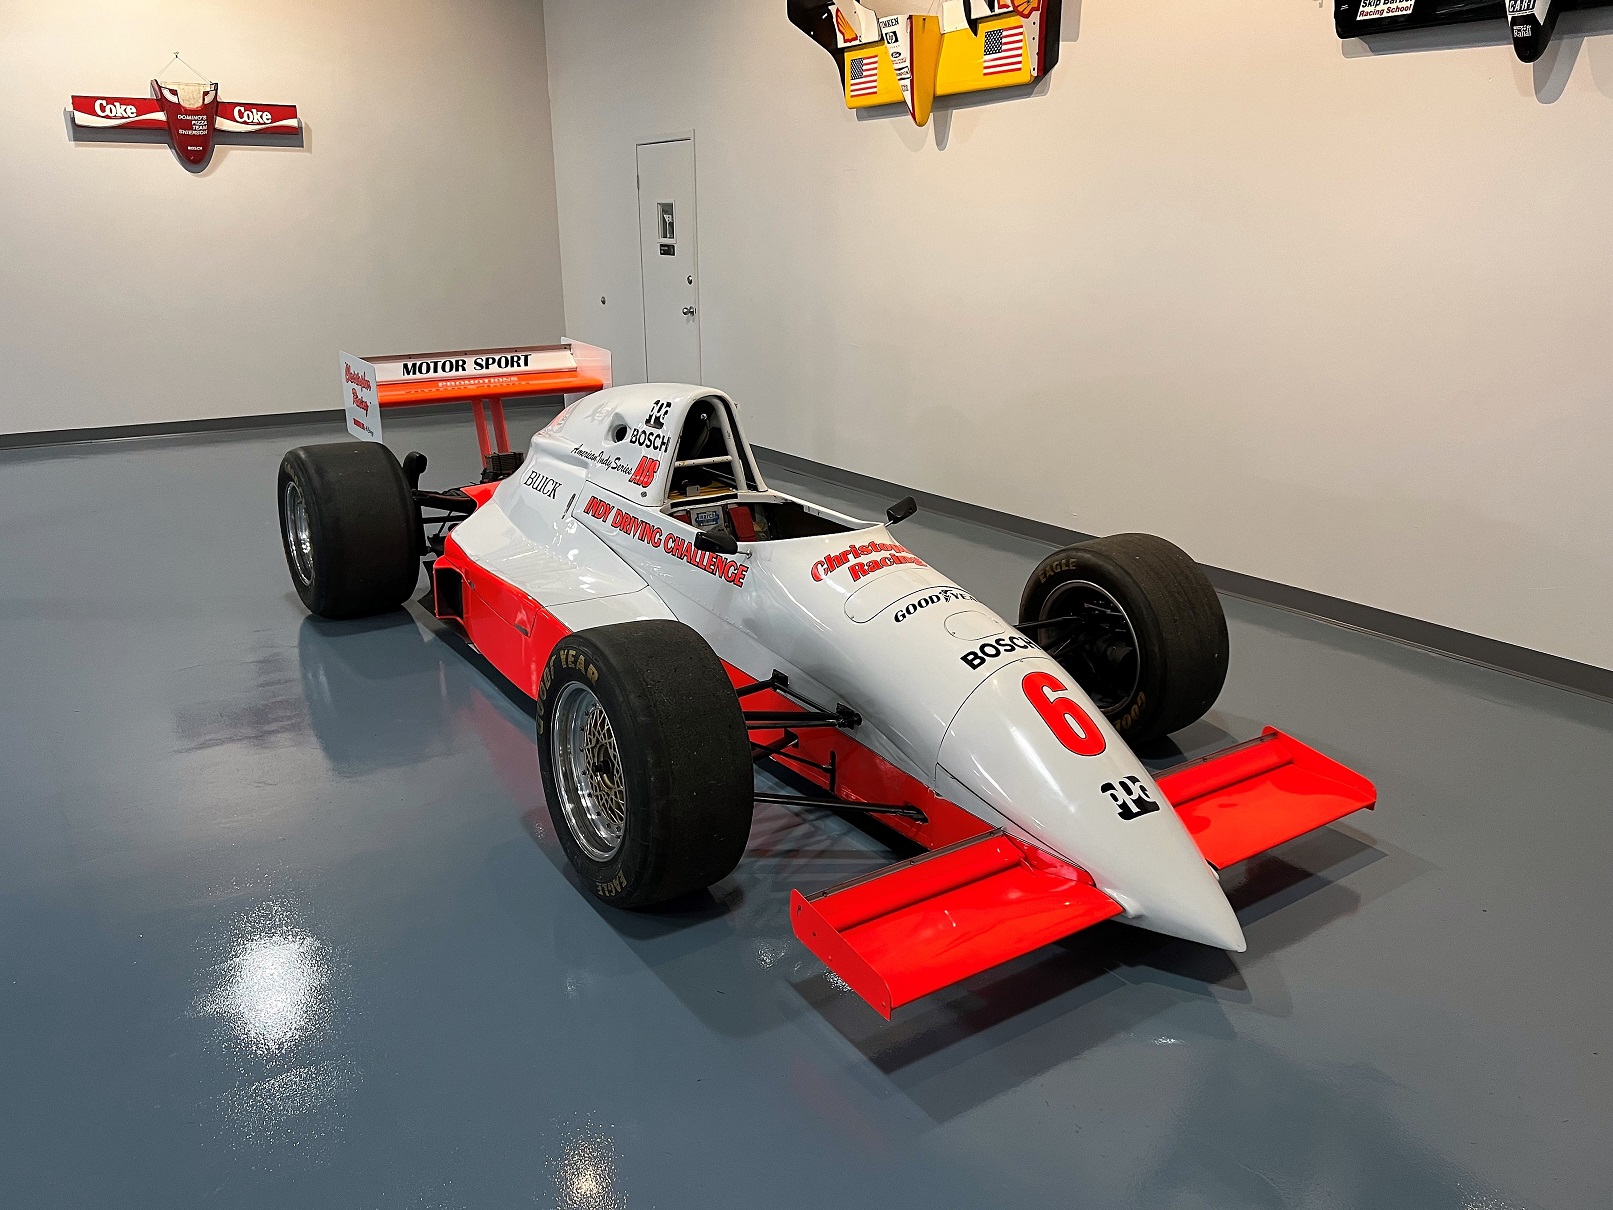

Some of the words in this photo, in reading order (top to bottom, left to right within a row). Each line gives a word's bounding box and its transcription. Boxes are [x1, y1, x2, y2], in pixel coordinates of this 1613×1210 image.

[1359, 9, 1385, 18] Racing
[1386, 4, 1412, 14] School
[94, 99, 137, 118] Coke
[233, 106, 272, 124] Coke
[402, 359, 467, 376] MOTOR
[473, 354, 532, 371] SPORT
[438, 376, 519, 388] PROMOTIONS
[629, 427, 671, 454] BOSCH
[611, 456, 634, 476] Series
[523, 469, 563, 500] BUICK
[583, 495, 615, 523] INDY
[611, 507, 663, 549] DRIVING
[663, 532, 750, 589] CHALLENGE
[1039, 558, 1078, 584] EAGLE
[960, 635, 1042, 671] BOSCH
[1021, 671, 1107, 757] 6
[595, 869, 628, 897] EAGLE
